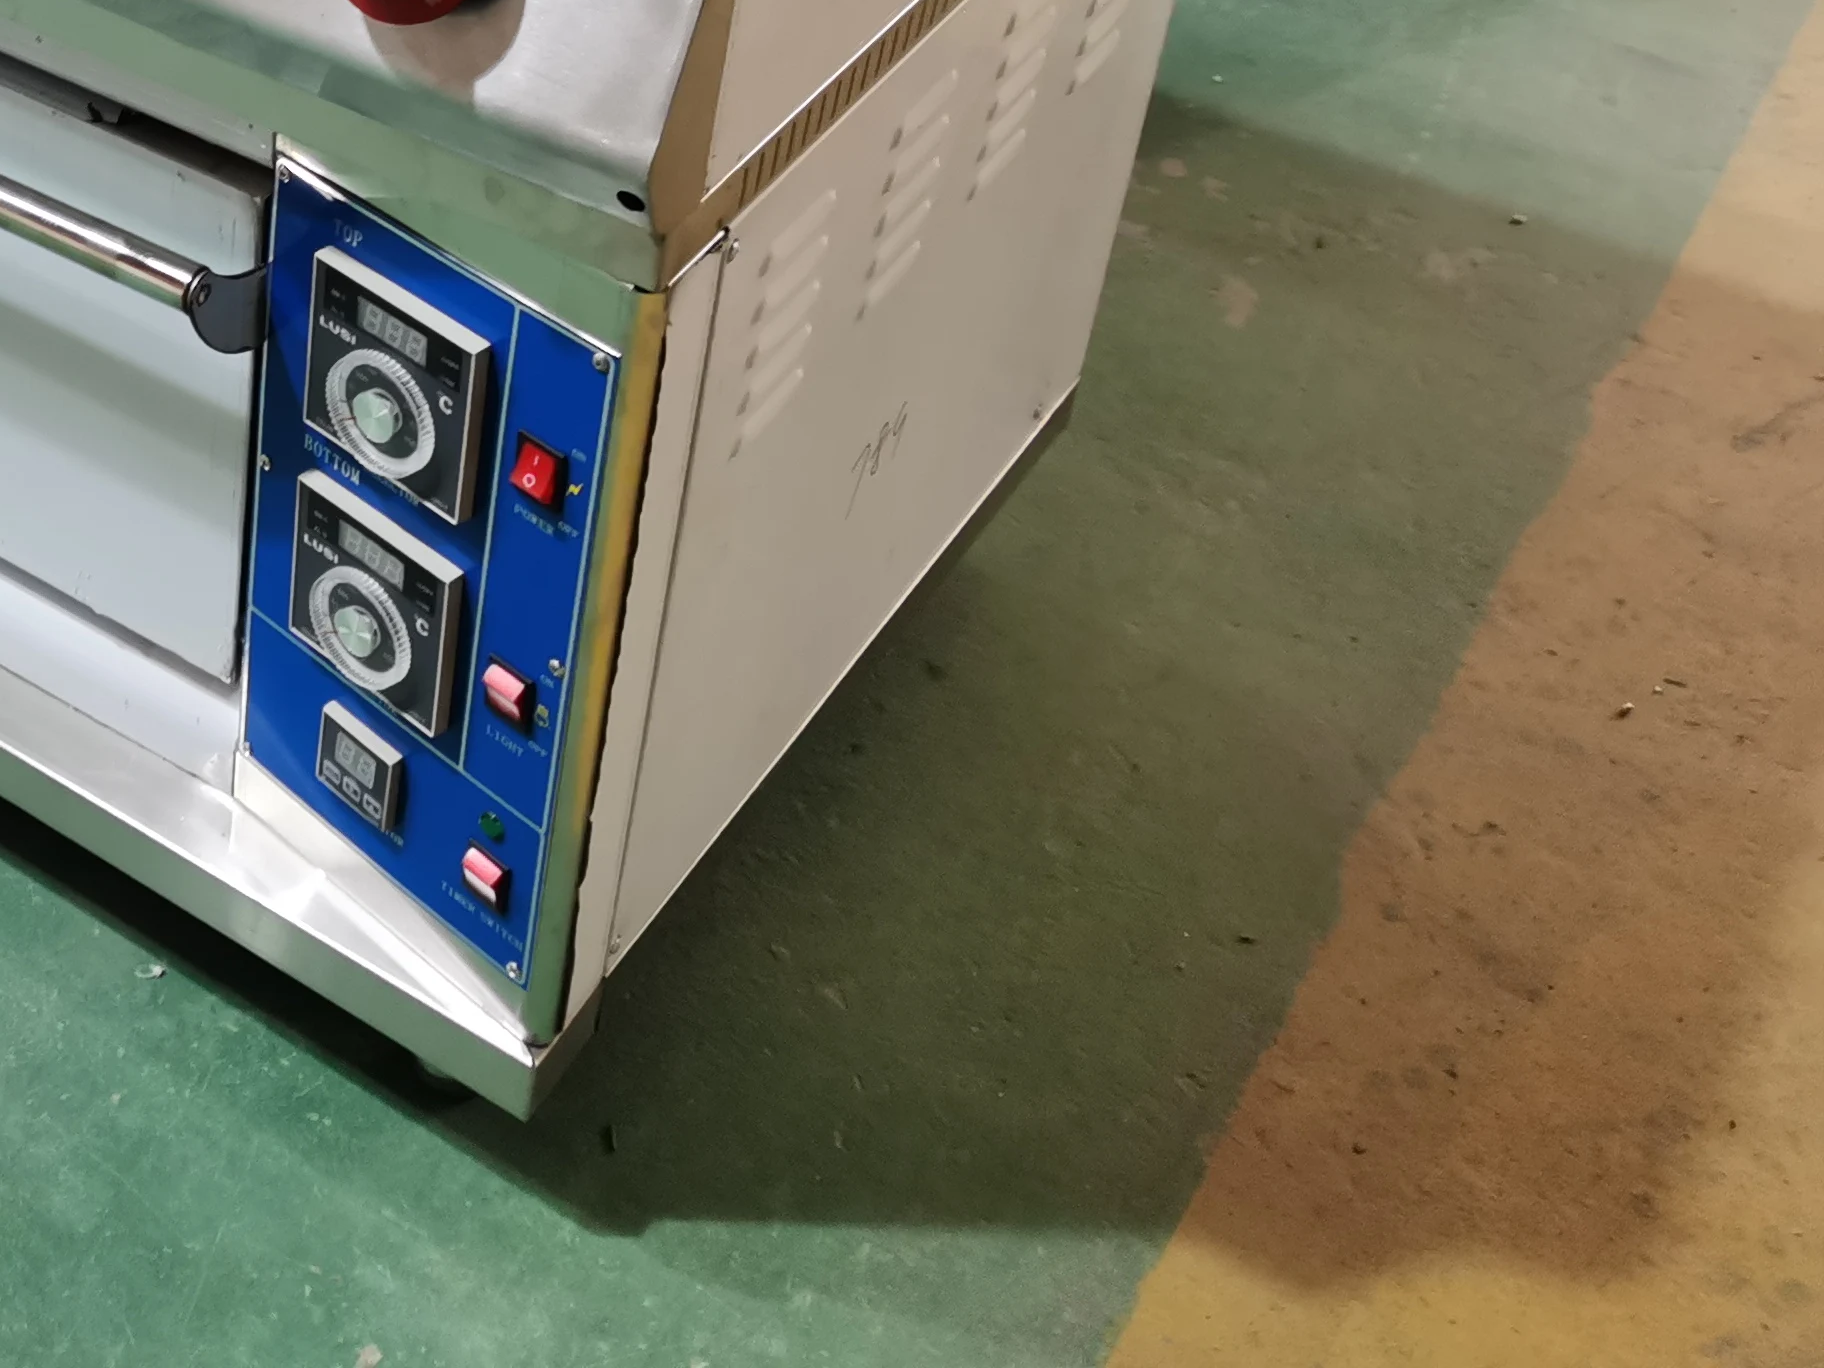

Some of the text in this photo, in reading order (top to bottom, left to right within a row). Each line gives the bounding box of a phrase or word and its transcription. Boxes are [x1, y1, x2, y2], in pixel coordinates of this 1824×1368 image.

[333, 218, 364, 248] TOP
[319, 314, 357, 346] LUSI
[304, 433, 361, 487] BOTTOM
[303, 533, 339, 565] LUSI
[486, 723, 524, 757] LIGHT
[440, 879, 524, 953] TIMER SWITCH
